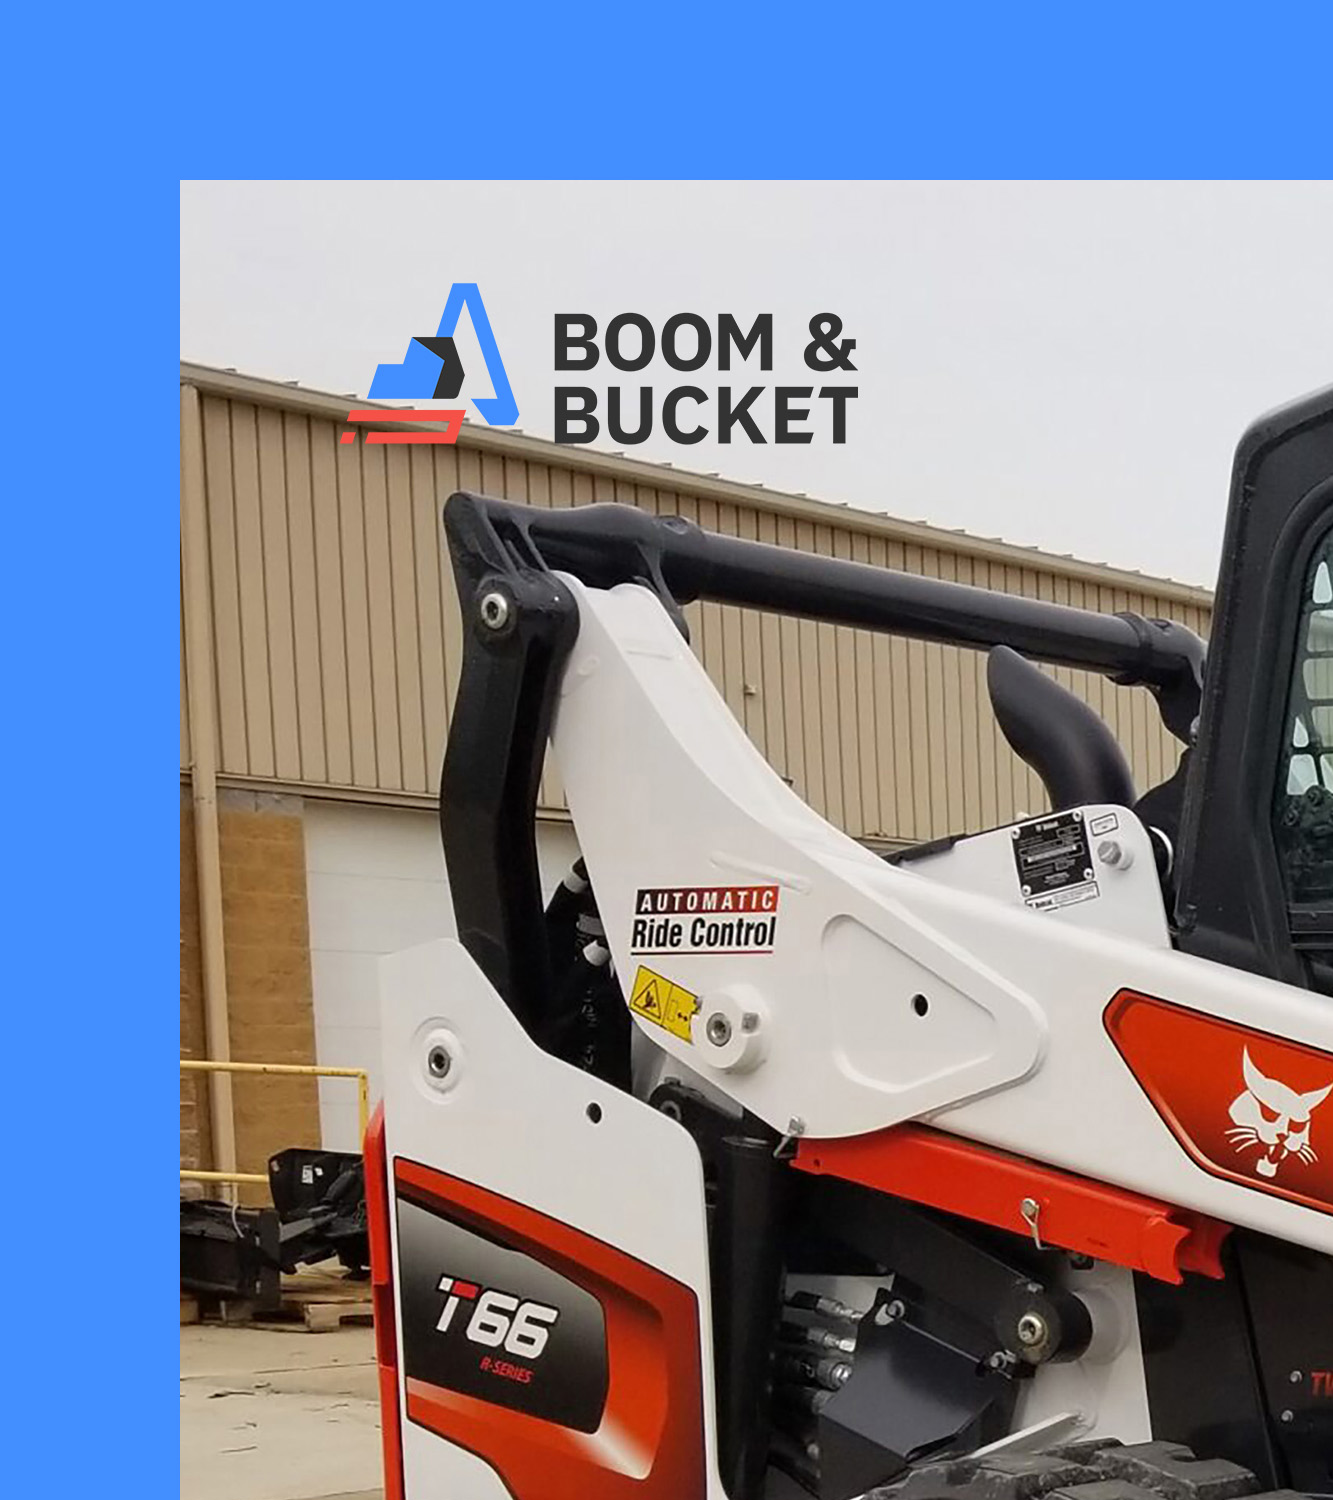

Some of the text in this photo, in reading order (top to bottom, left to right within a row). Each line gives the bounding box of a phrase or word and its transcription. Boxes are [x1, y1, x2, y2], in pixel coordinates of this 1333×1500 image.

[640, 889, 774, 912] AUTOMATIC
[631, 916, 777, 948] Ride Control
[435, 1276, 559, 1360] T66
[479, 1356, 534, 1384] R-SERIES
